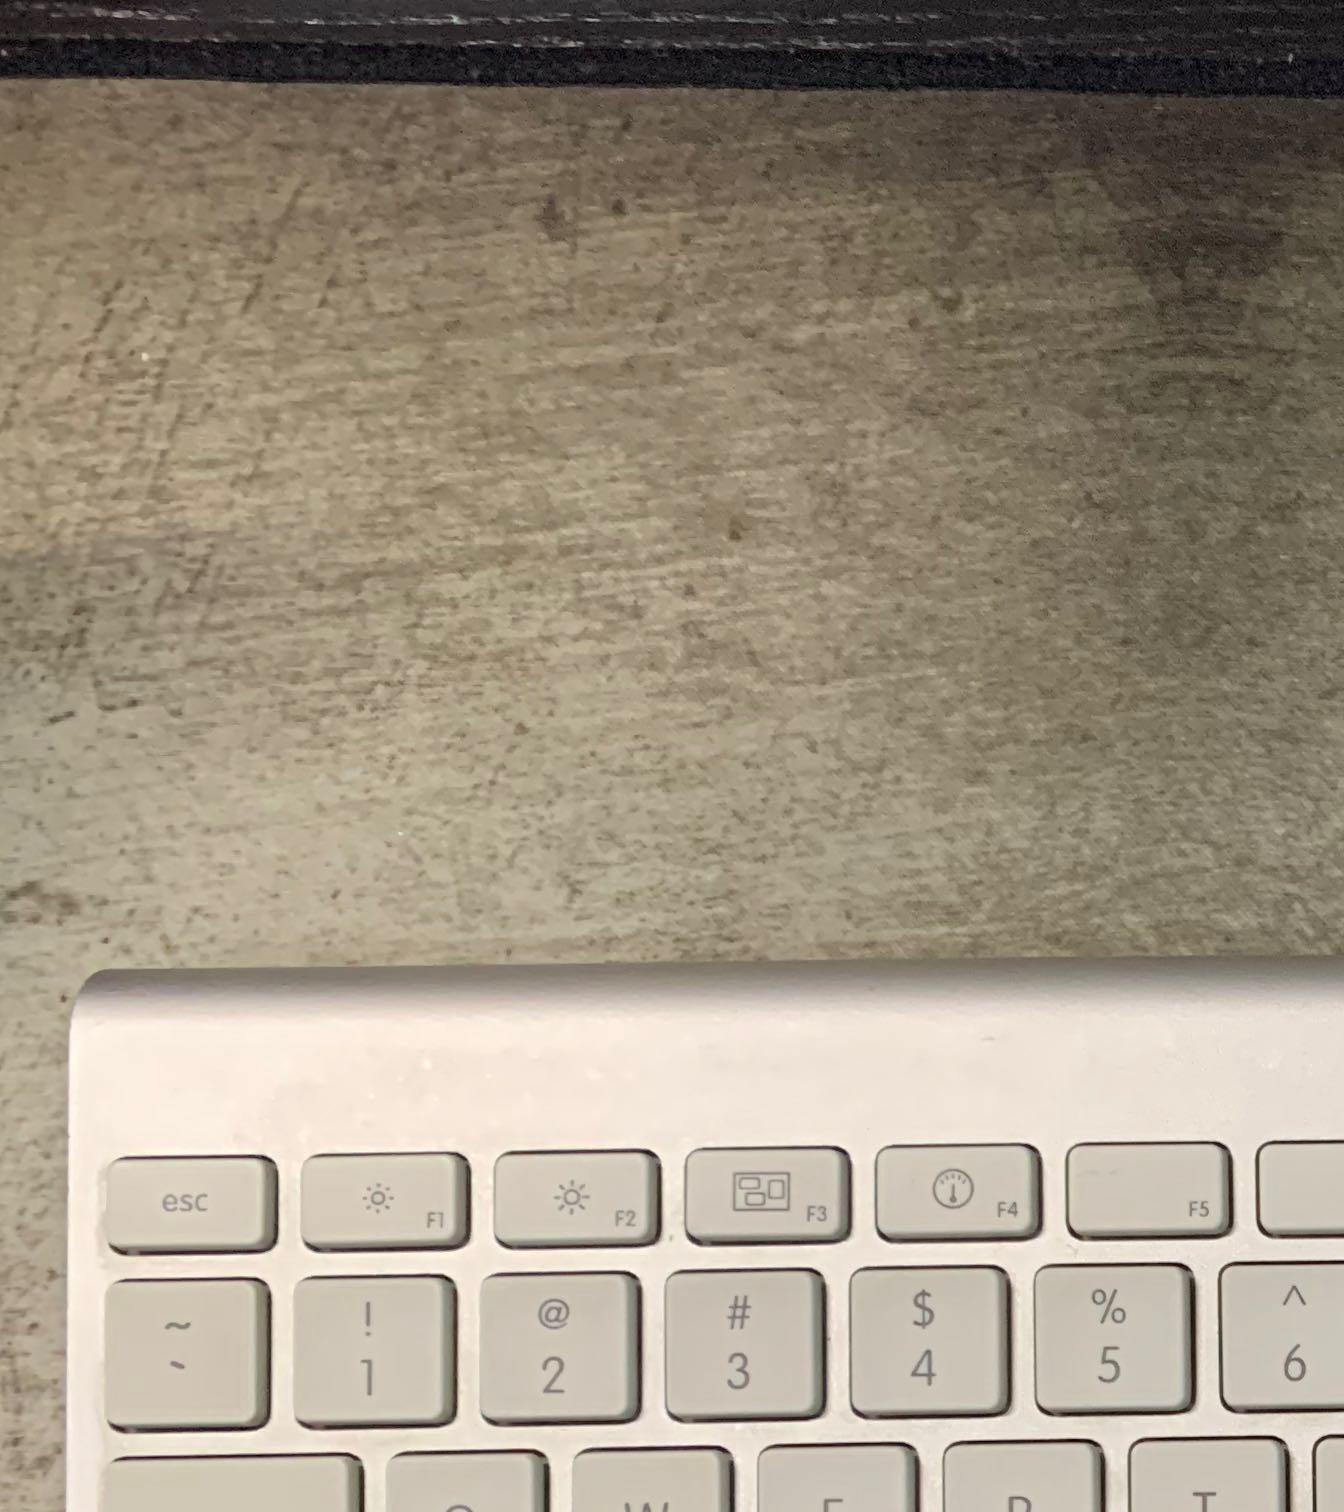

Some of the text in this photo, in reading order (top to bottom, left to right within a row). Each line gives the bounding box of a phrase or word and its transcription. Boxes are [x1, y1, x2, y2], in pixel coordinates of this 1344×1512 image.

[160, 1192, 210, 1214] esc
[425, 1210, 446, 1230] F1
[613, 1208, 638, 1229] F2
[805, 1203, 829, 1224] F3
[996, 1200, 1020, 1219] F4
[1187, 1199, 1211, 1219] F5
[726, 1294, 753, 1331] #
[911, 1287, 936, 1331] $
[1091, 1288, 1127, 1325] %
[1281, 1283, 1308, 1307] ^
[364, 1300, 373, 1338] !
[537, 1298, 570, 1330] @
[359, 1357, 374, 1398] 1
[540, 1354, 566, 1395] 2
[726, 1351, 751, 1391] 3
[910, 1348, 937, 1387] 4
[1096, 1344, 1122, 1385] 5
[1282, 1342, 1308, 1383] 6
